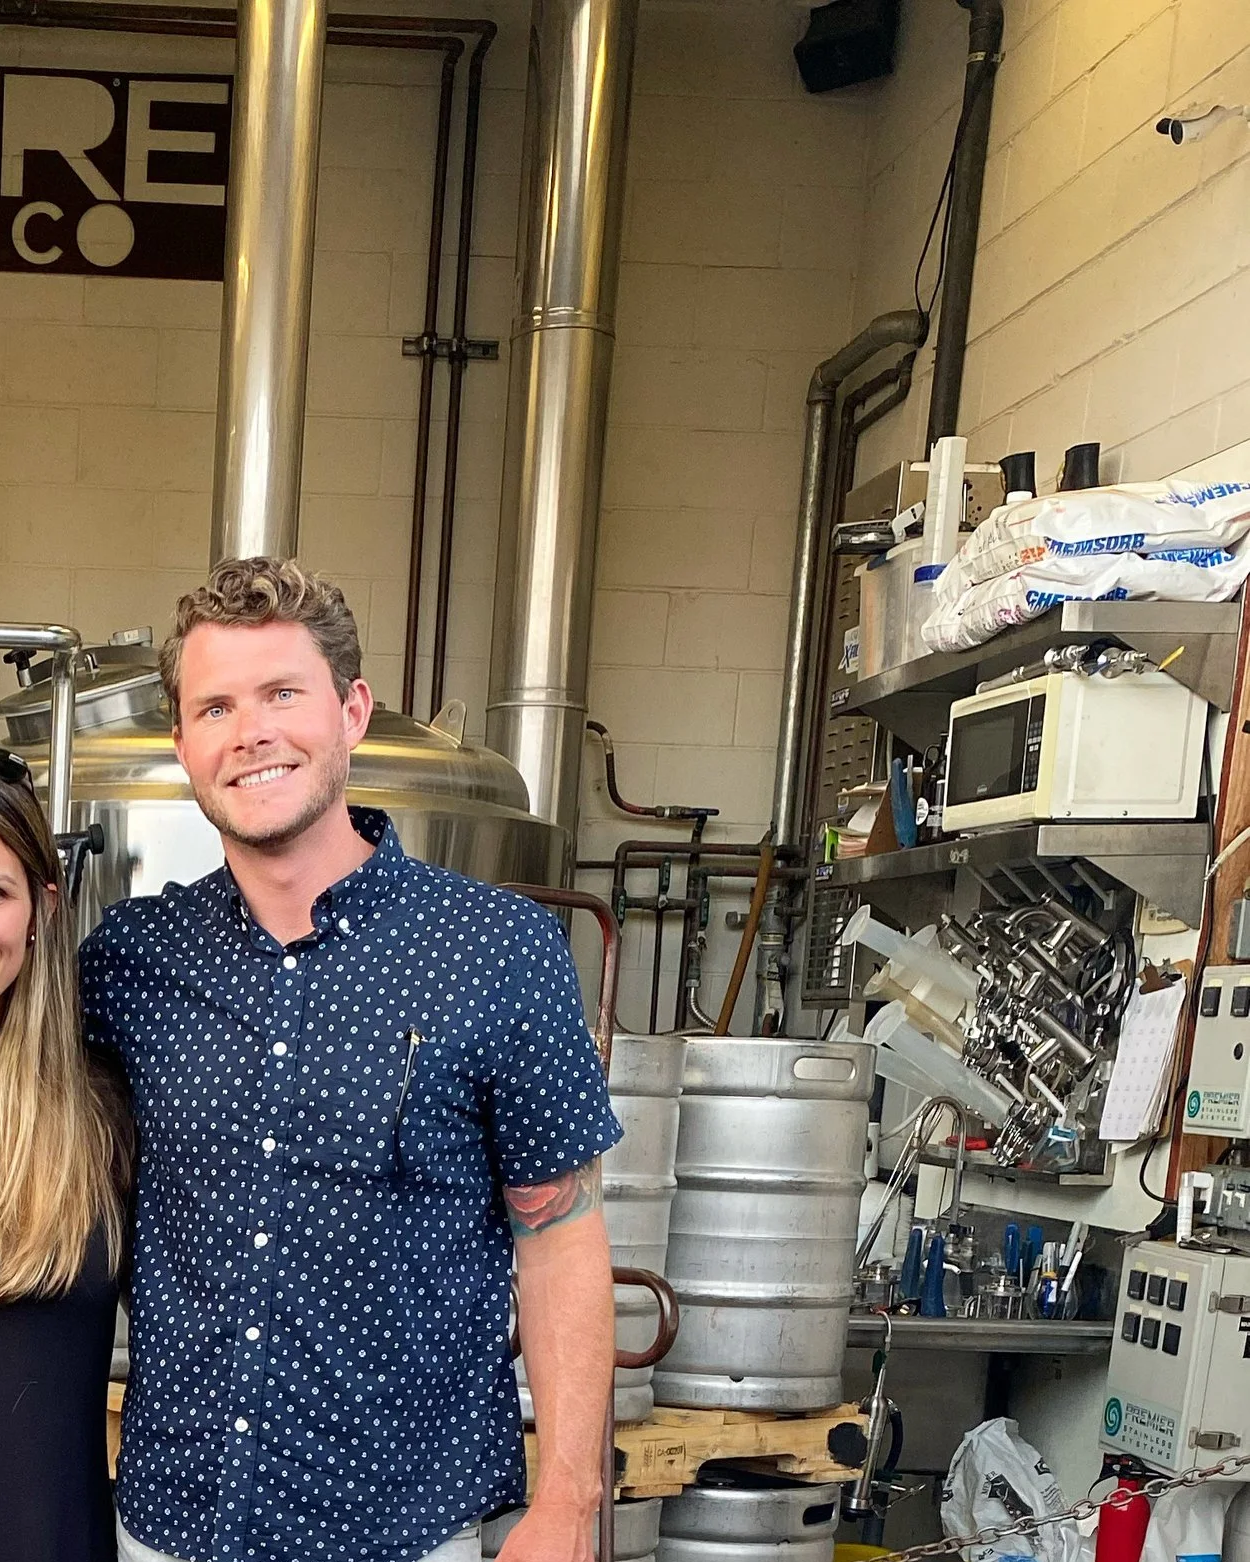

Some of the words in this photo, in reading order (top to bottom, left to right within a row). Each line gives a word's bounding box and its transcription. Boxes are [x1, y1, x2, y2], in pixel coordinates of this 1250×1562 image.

[1125, 1403, 1175, 1437] PREMIER
[1122, 1435, 1170, 1459] SYSTEMS
[1123, 1425, 1172, 1449] STAINLESS
